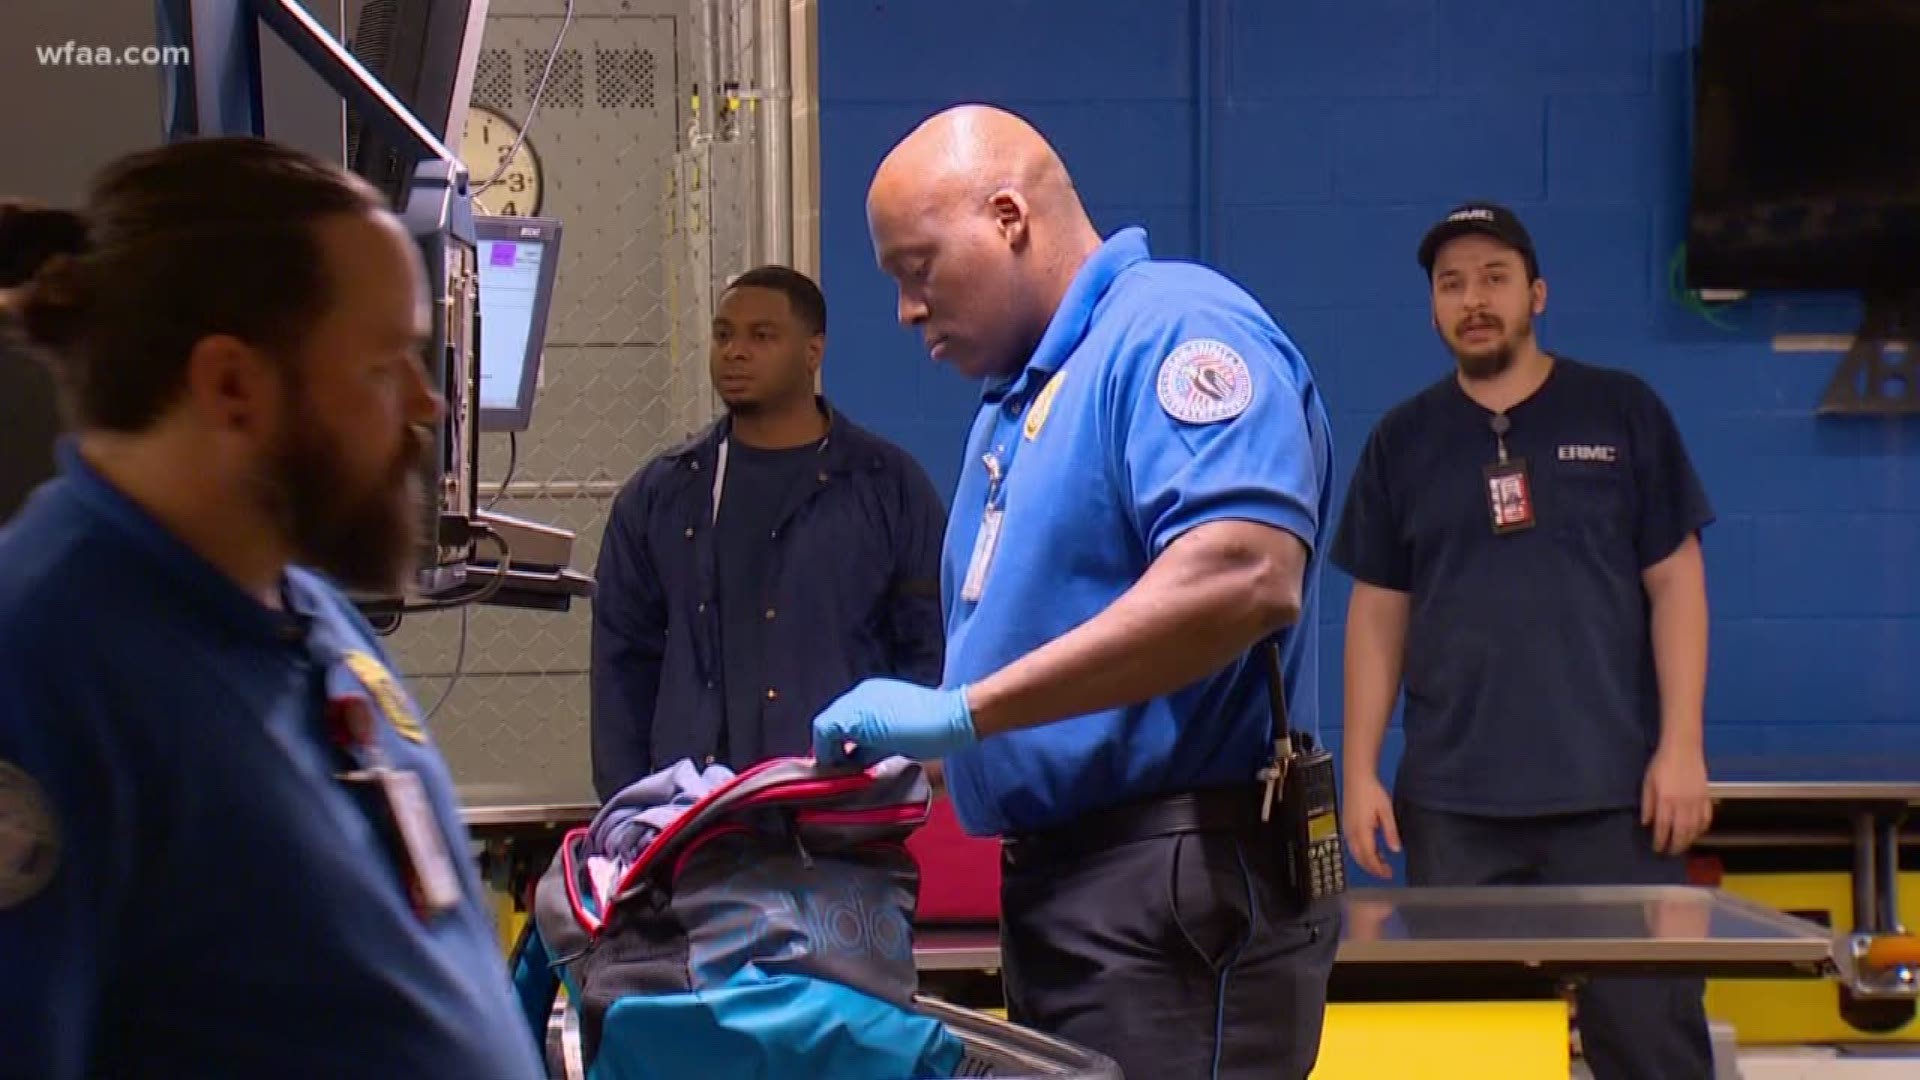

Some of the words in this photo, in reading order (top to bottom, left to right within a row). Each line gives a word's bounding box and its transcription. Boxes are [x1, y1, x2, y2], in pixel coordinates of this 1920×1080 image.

[483, 125, 490, 145] 1
[508, 173, 525, 193] 3
[501, 200, 517, 216] 4
[1558, 444, 1616, 461] ERMC
